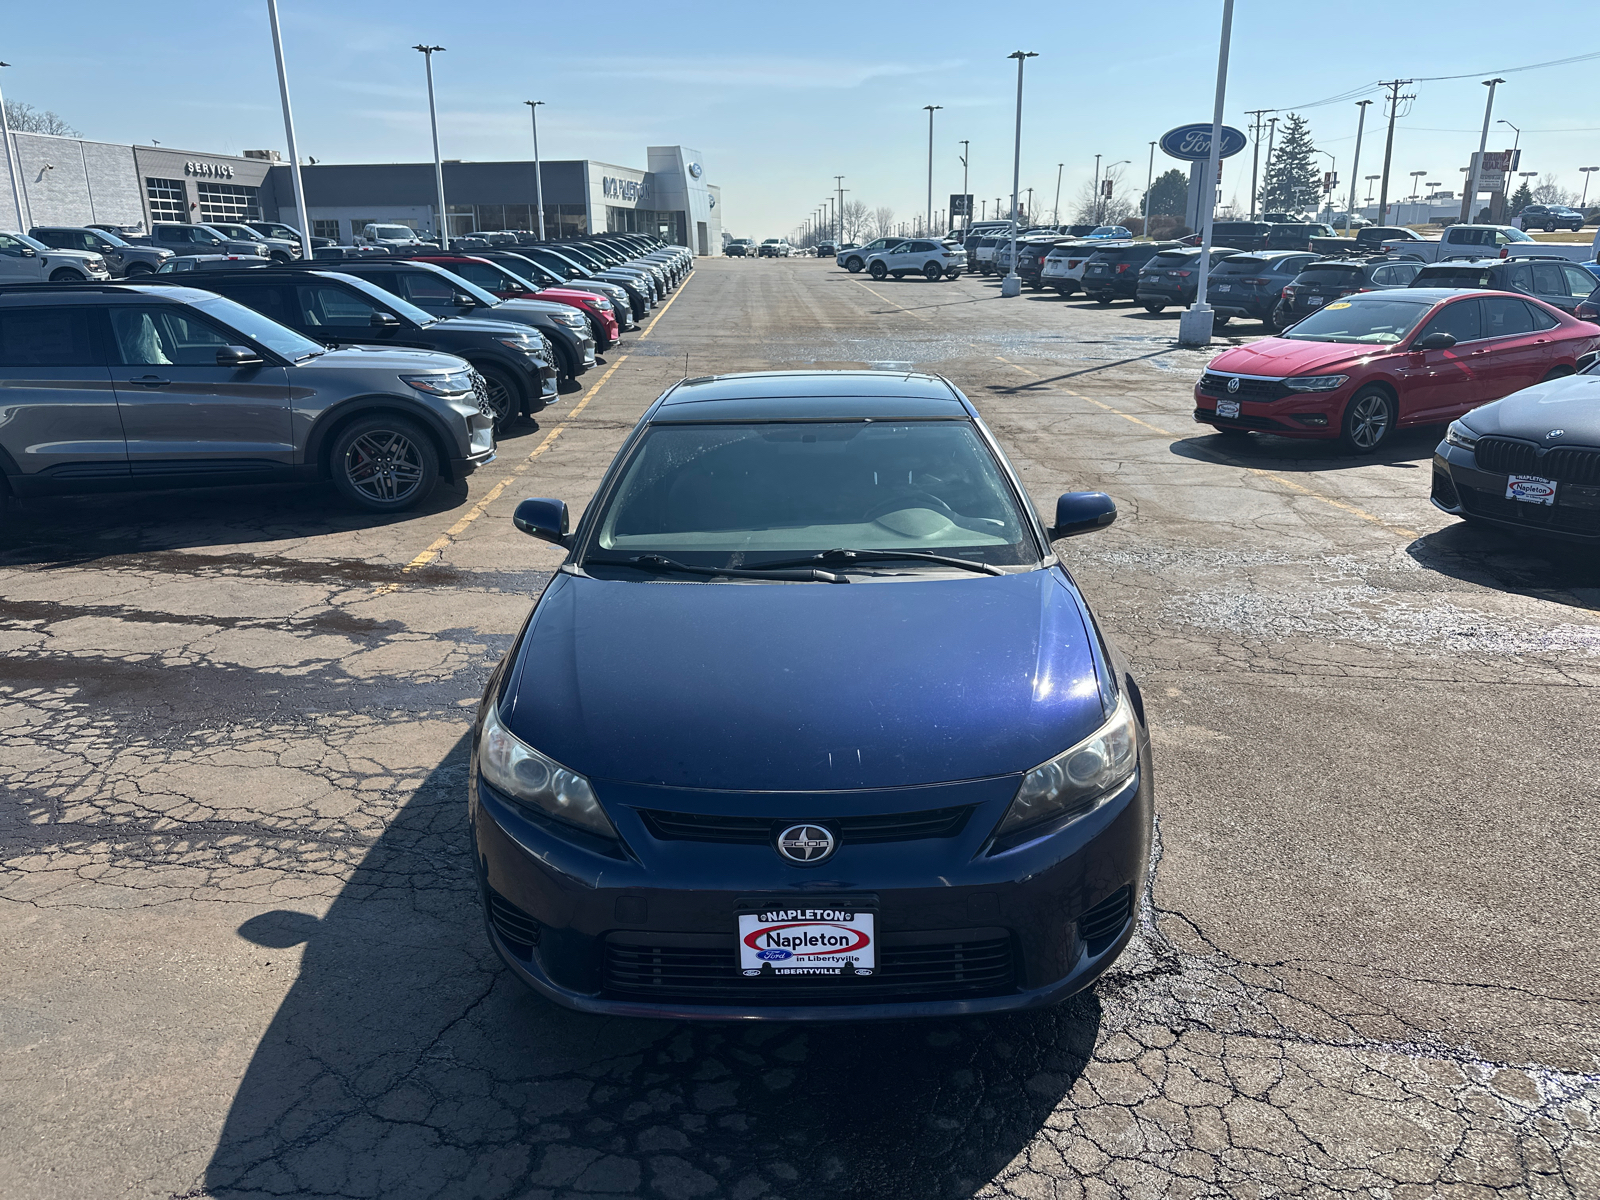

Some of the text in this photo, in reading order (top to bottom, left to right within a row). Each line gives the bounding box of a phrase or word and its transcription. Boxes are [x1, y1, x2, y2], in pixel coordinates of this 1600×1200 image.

[187, 162, 235, 176] SERVICE
[603, 176, 650, 200] NAPLETON
[1516, 484, 1547, 494] Napleton
[766, 910, 845, 921] NAPLETON
[766, 932, 850, 950] Napleton
[763, 950, 787, 959] Ford
[807, 955, 860, 963] Libertyville
